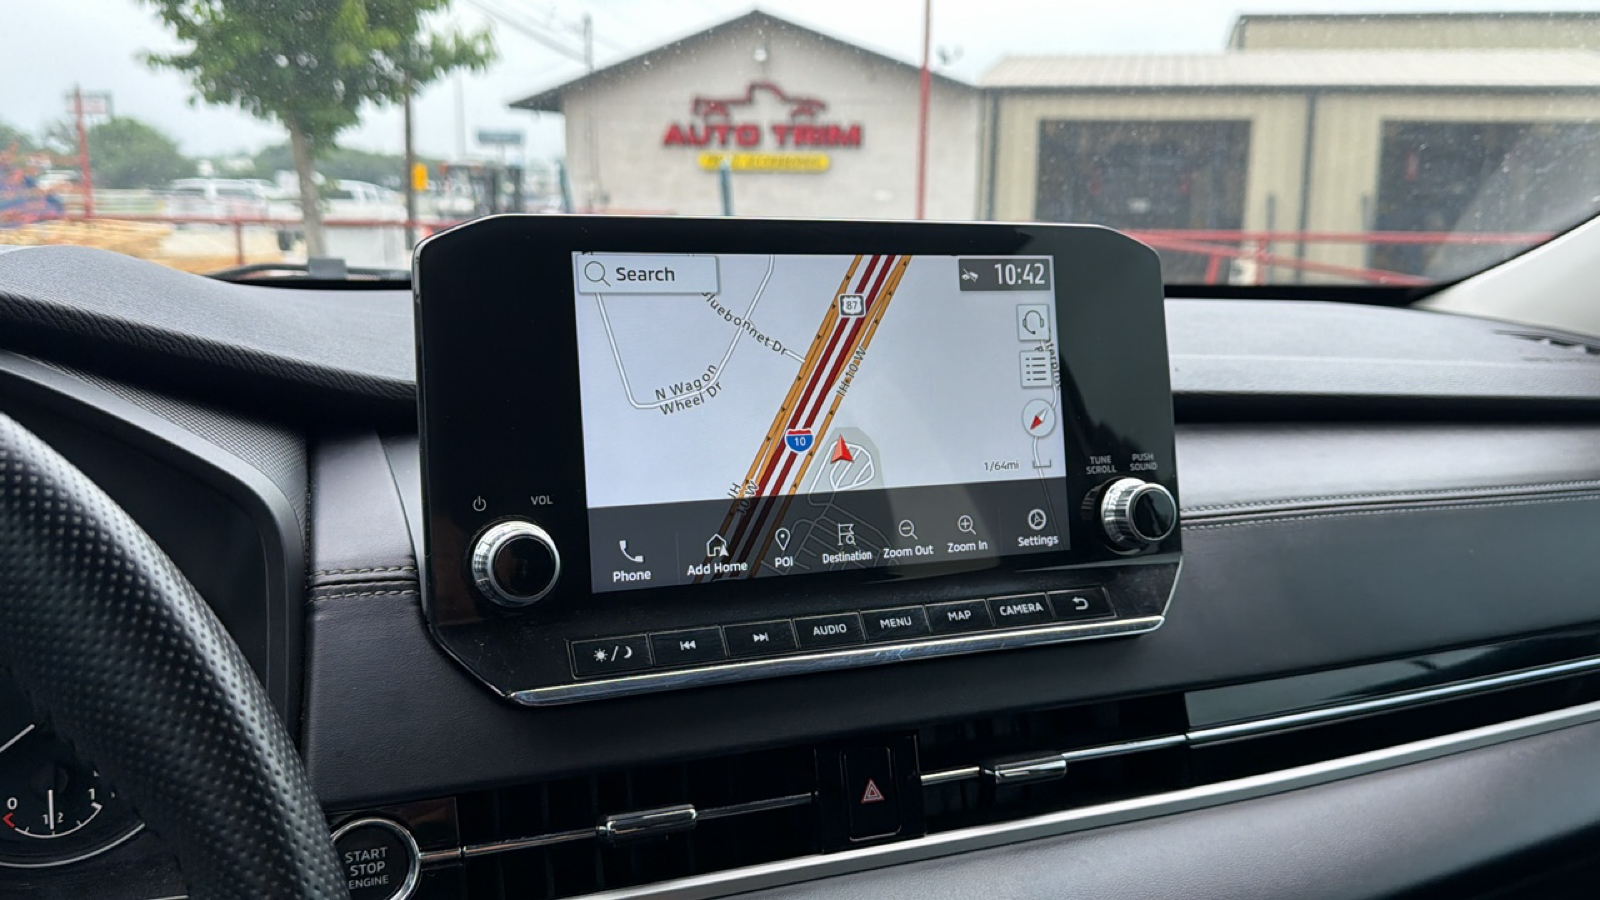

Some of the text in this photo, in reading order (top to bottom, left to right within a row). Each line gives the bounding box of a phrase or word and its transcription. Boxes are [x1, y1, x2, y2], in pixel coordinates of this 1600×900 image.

[663, 123, 862, 146] AUTO TRIM
[616, 266, 676, 282] Search
[994, 263, 1046, 285] 10:42
[846, 301, 858, 311] 87
[771, 340, 787, 355] Dr
[655, 365, 717, 400] N Wagon
[660, 381, 722, 415] Wheel Dr
[794, 437, 806, 447] 10
[1089, 455, 1112, 465] TUNE
[1131, 453, 1155, 462] PUSH
[984, 460, 1020, 472] 1/64mi
[1086, 465, 1117, 475] SCROLL
[1129, 462, 1158, 471] SOUND
[530, 495, 554, 505] VOL
[947, 540, 988, 553] Zoom In
[1018, 534, 1059, 547] Settings
[822, 550, 873, 564] Destination
[883, 545, 934, 559] Zoom Out
[687, 561, 748, 576] Add Home
[774, 556, 794, 568] POI
[613, 570, 652, 583] Phone
[948, 610, 972, 621] MAP
[999, 602, 1044, 616] CAMERA
[880, 616, 912, 629] MENU
[812, 623, 847, 636] AUDIO
[345, 846, 388, 864] START
[350, 861, 386, 876] STOP
[348, 875, 390, 890] ENGINE
